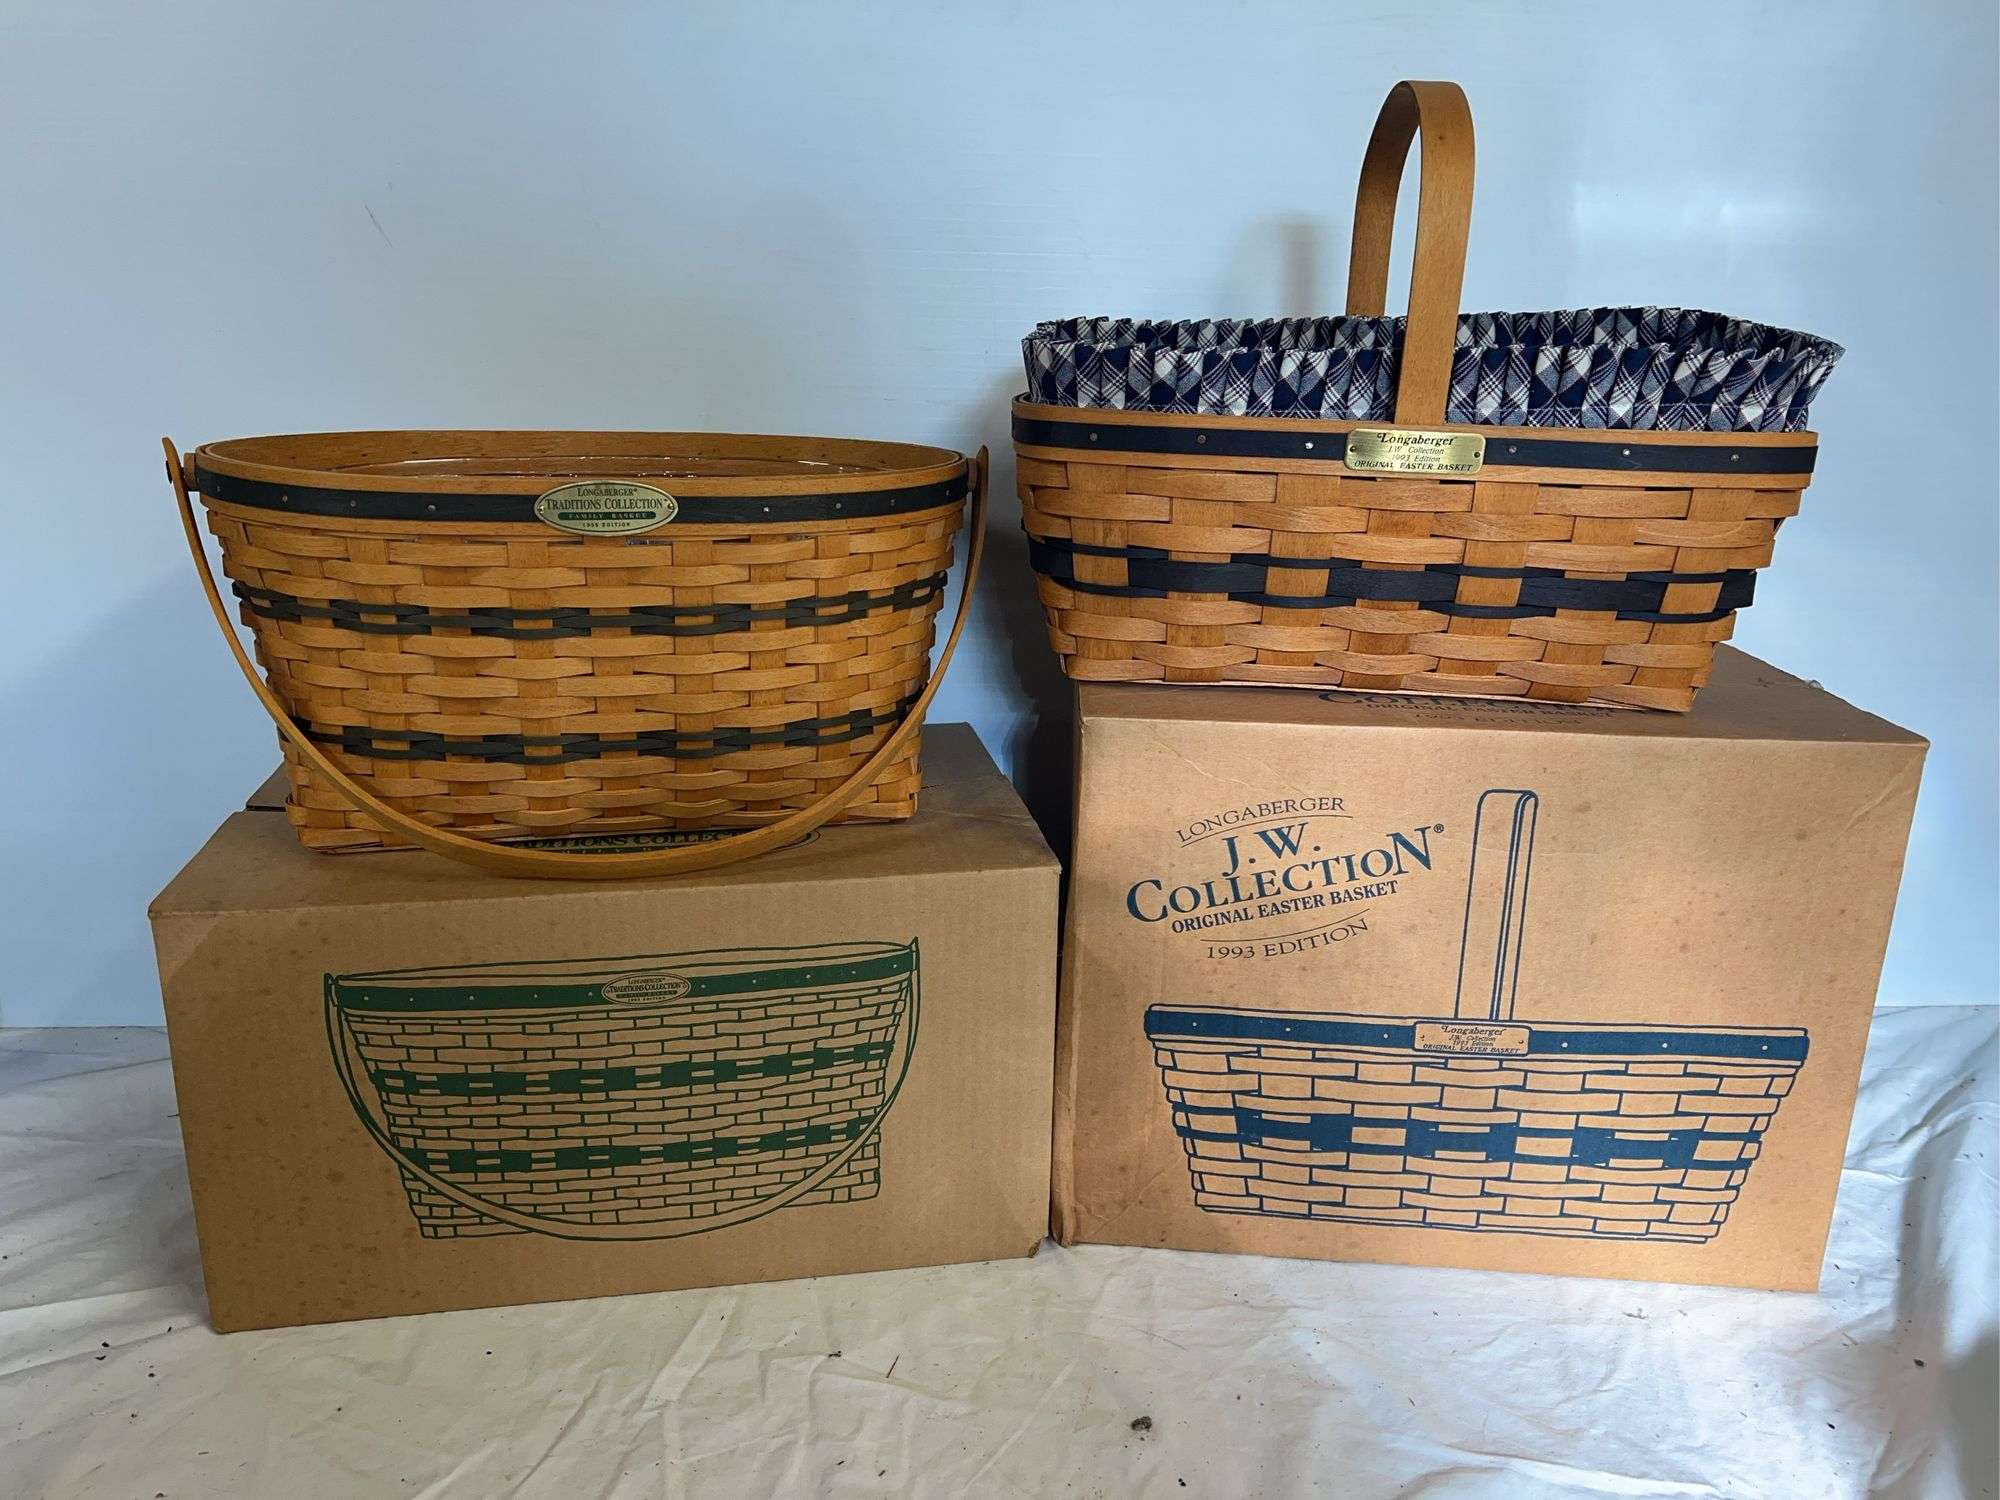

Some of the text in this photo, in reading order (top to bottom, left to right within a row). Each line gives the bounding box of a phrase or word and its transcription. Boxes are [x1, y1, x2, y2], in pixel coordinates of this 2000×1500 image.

[1377, 433, 1457, 446] Longaberger
[1408, 446, 1444, 455] Collection
[1414, 454, 1441, 462] Edition
[1354, 460, 1474, 471] ORIGINAL EASTER BASKET
[545, 498, 663, 510] TRADITIONS COLLECTION
[1176, 797, 1344, 842] LONGABERGER
[1171, 880, 1399, 934] ORIGINAL EASTER BASKET
[1207, 918, 1368, 959] 1993 EDITION
[1441, 1025, 1506, 1037] Longaberger
[1423, 1043, 1456, 1051] ORIGINAL
